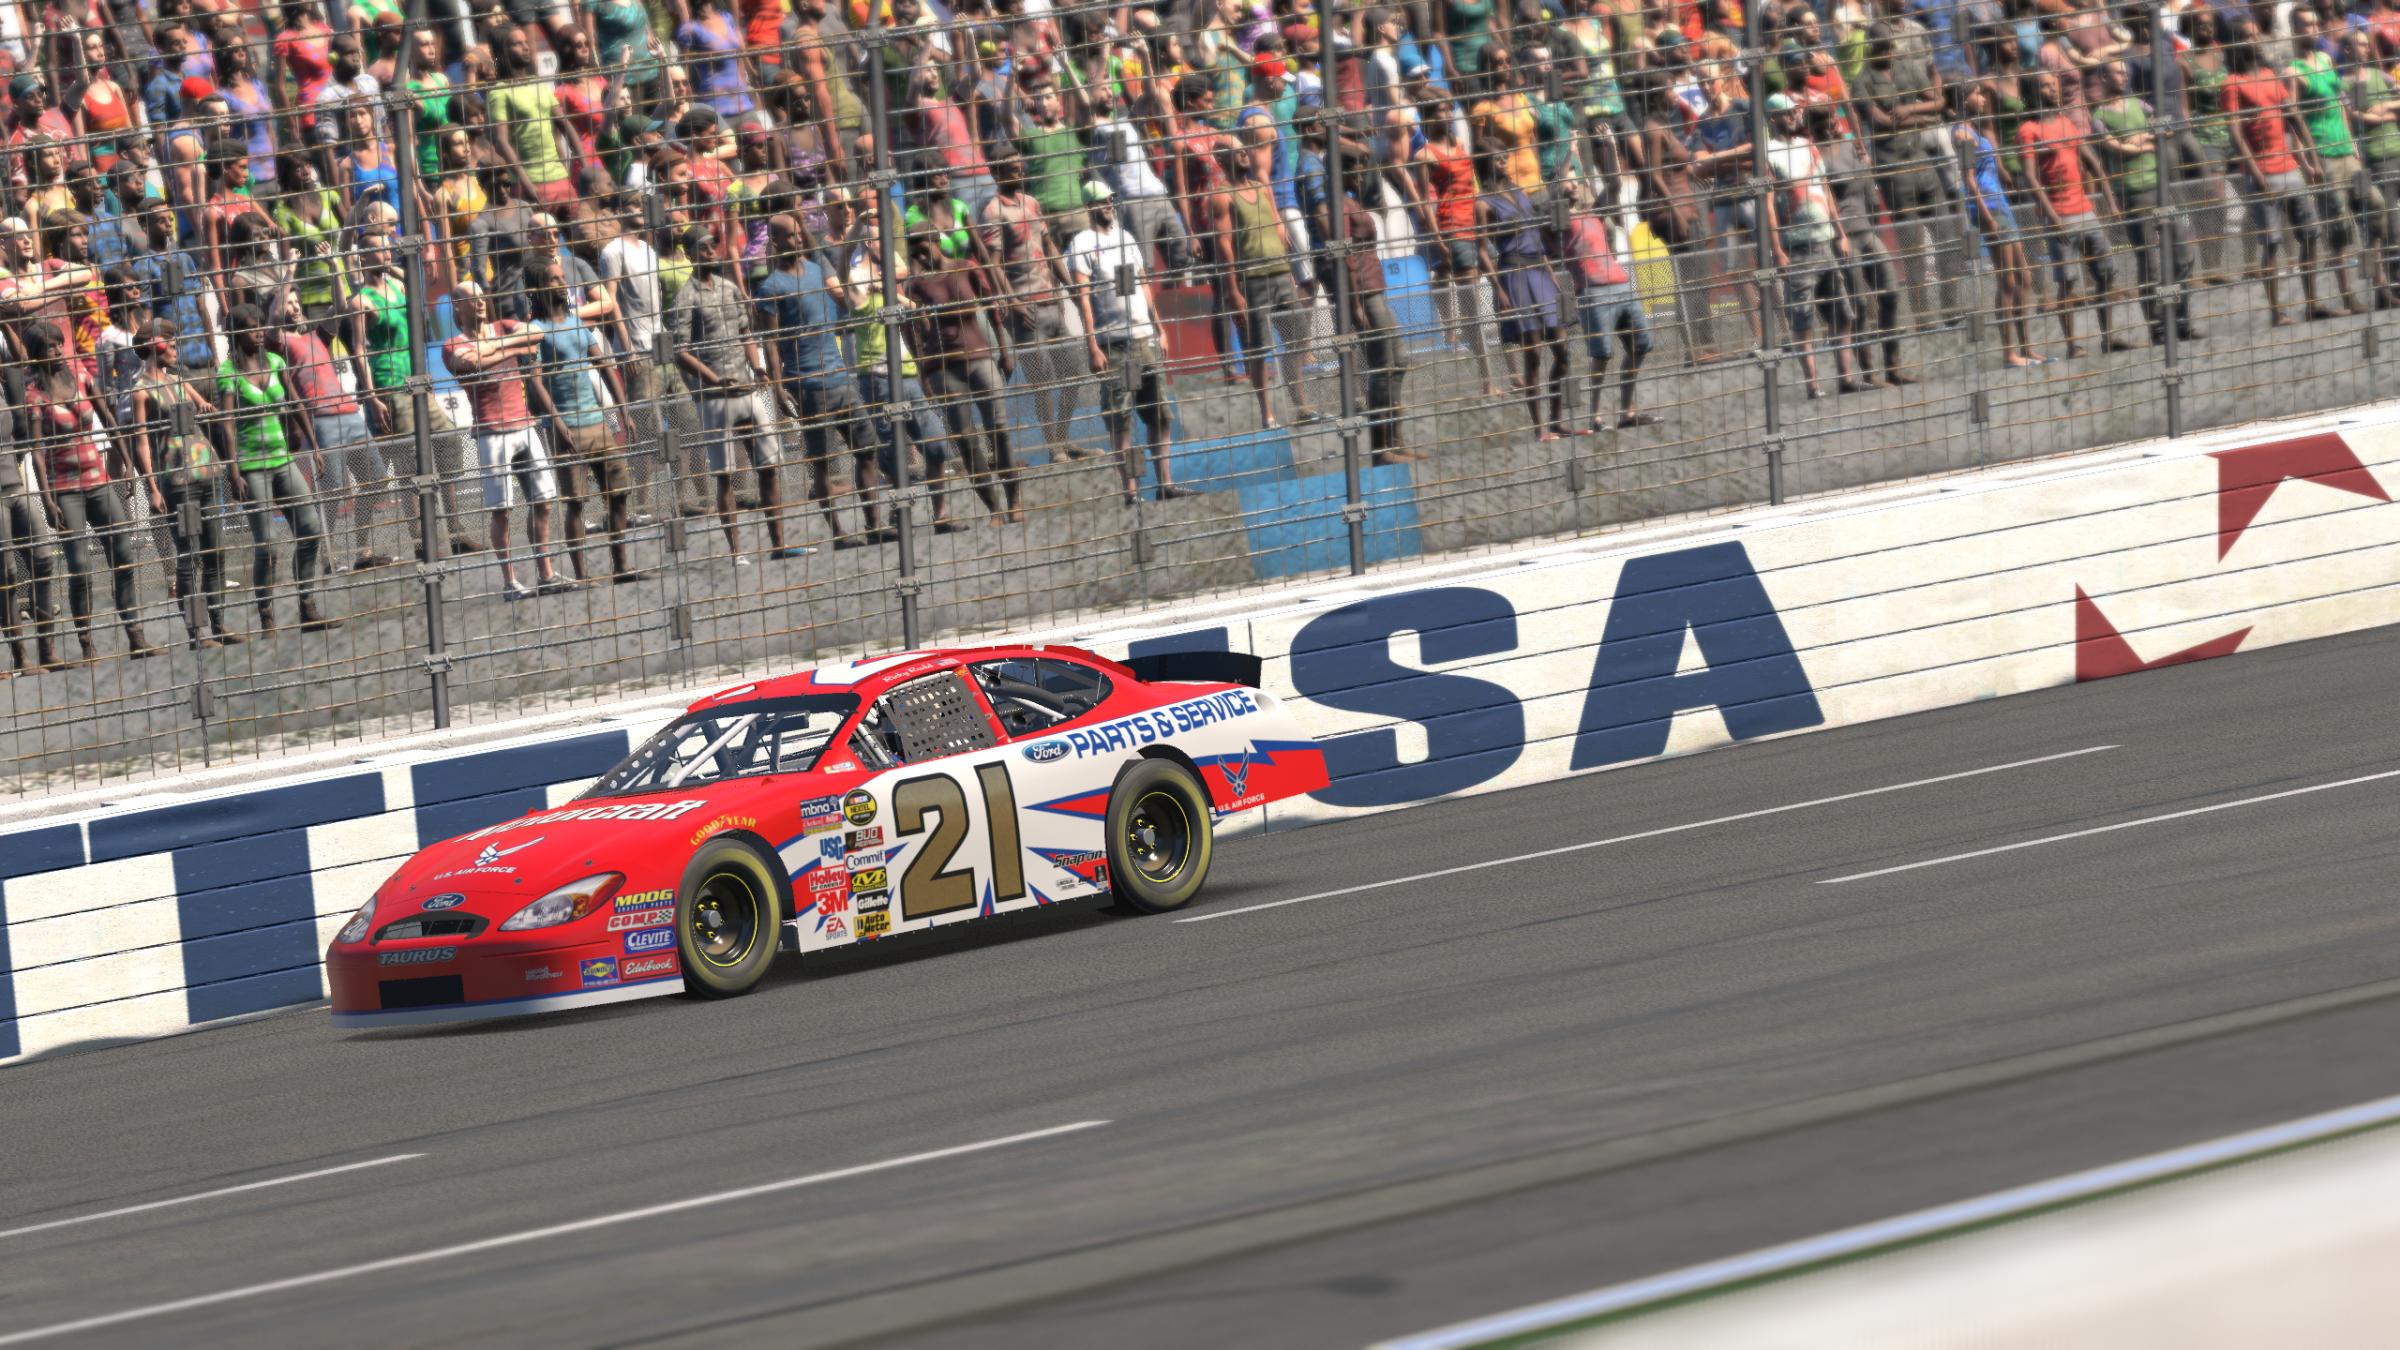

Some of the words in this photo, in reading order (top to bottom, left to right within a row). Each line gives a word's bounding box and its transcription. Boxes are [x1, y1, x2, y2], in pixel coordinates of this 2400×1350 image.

[1031, 742, 1064, 760] Ford
[1066, 716, 1157, 760] PARTS
[1152, 711, 1175, 738] &
[1169, 689, 1258, 733] SERVICE
[1231, 800, 1243, 808] AIR
[1243, 792, 1265, 805] FORCE
[801, 803, 830, 817] mbna
[855, 827, 879, 842] BUD
[890, 760, 1028, 923] 21
[819, 835, 844, 861] USG
[846, 850, 883, 870] Commit
[474, 865, 518, 875] FORCE
[809, 869, 845, 886] Holley
[427, 893, 458, 909] Ford
[615, 888, 674, 908] MOOG
[817, 888, 849, 916] 3M
[609, 911, 658, 929] COMP
[826, 916, 847, 933] EA
[865, 913, 885, 923] Auto
[825, 929, 848, 941] SPORTS
[864, 921, 890, 933] Meter
[627, 929, 672, 948] CLEVITE
[379, 947, 457, 966] TAURUS
[625, 958, 673, 975] Edelbrock
